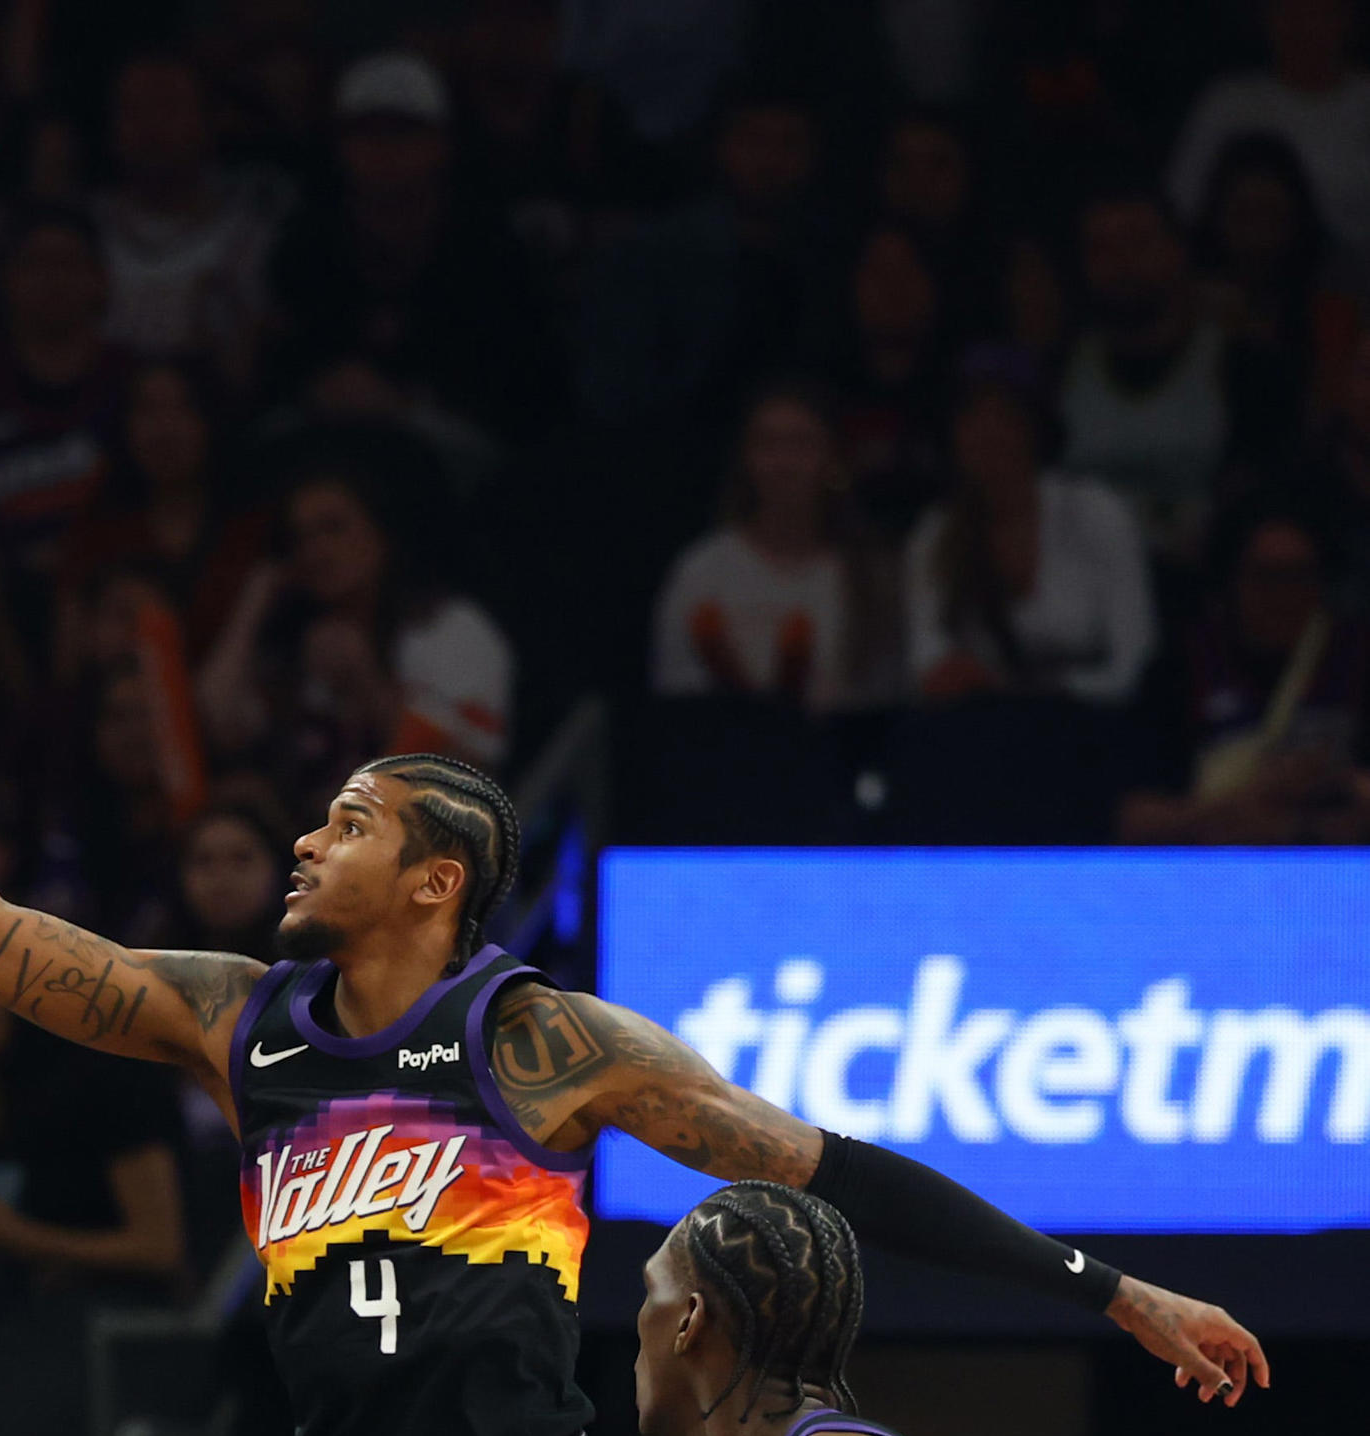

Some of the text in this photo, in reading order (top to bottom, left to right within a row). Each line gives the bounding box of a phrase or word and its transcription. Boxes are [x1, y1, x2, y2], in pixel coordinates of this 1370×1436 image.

[398, 1041, 460, 1071] PayPal
[257, 1124, 468, 1251] Valley
[291, 1147, 331, 1176] THE
[349, 1258, 401, 1354] 4
